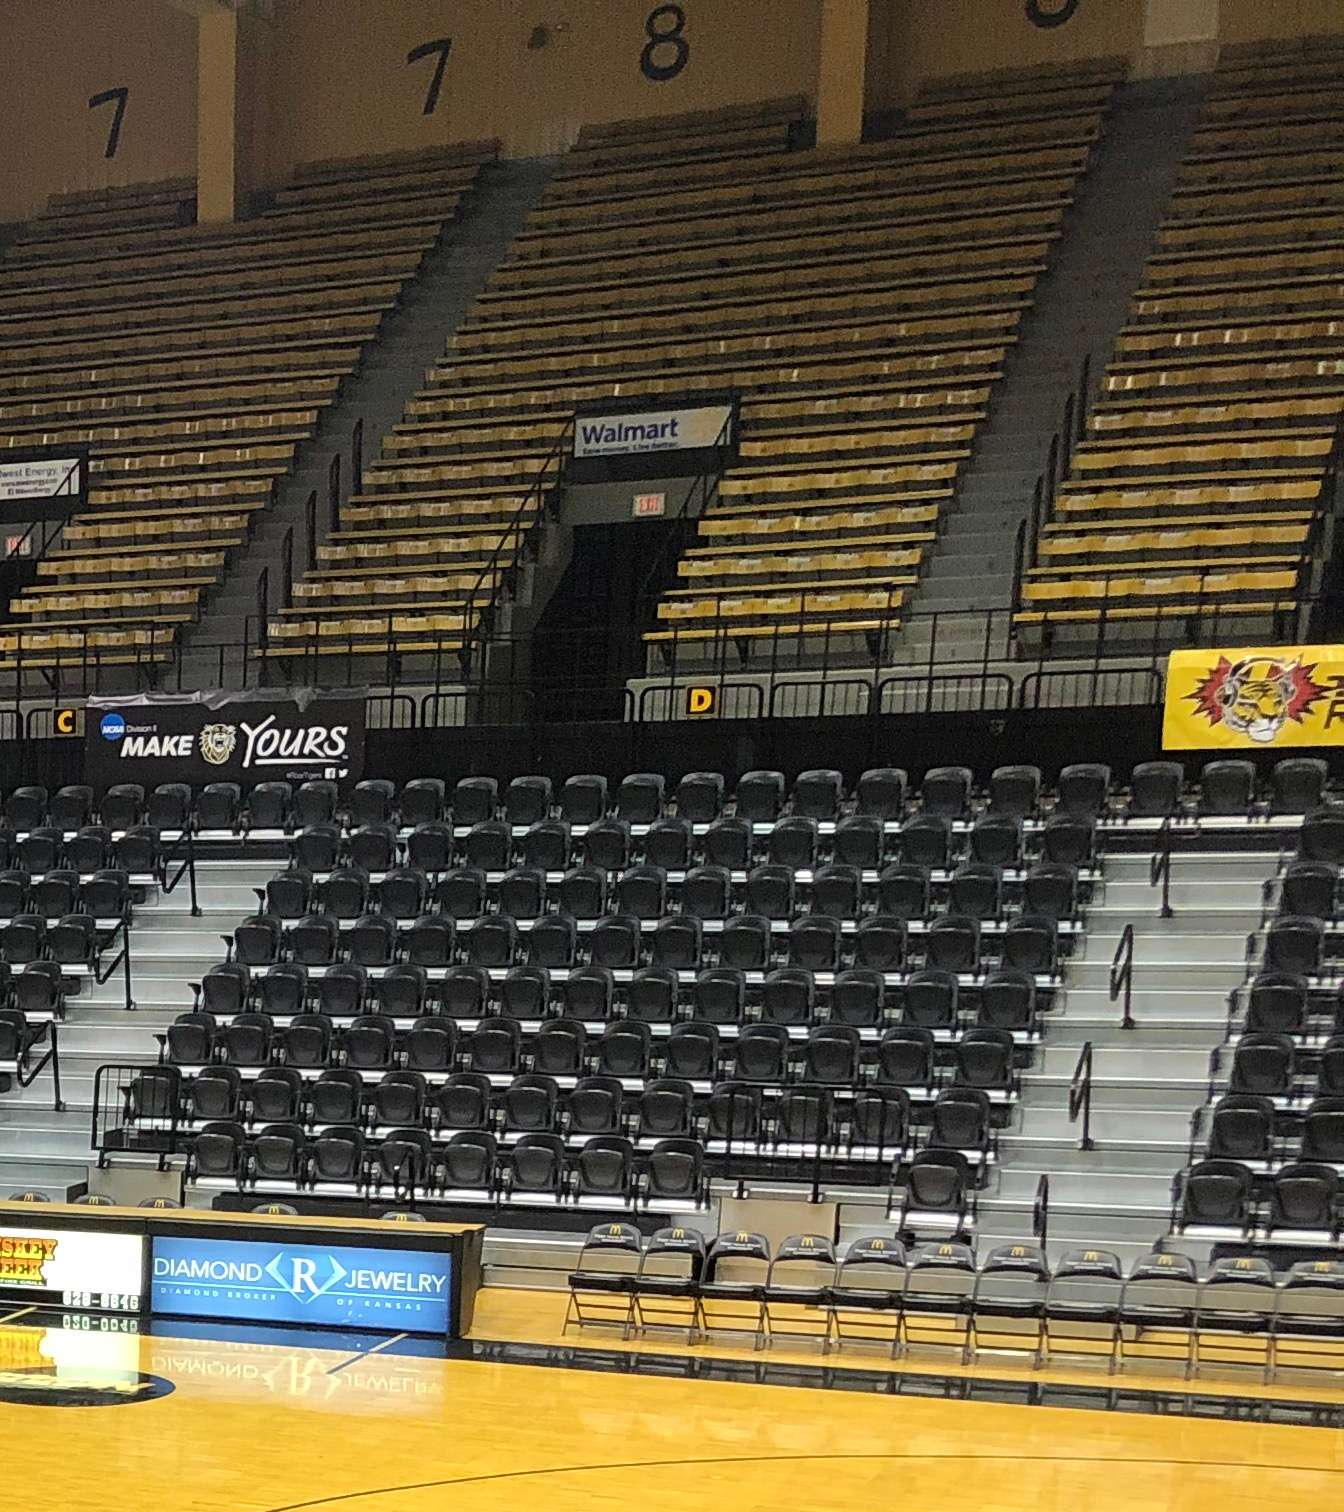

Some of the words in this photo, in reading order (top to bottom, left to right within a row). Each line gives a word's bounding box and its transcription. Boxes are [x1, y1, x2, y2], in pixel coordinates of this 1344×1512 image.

[640, 3, 690, 82] 8
[406, 38, 453, 116] 7
[88, 86, 130, 159] 7
[582, 418, 678, 444] Walmart
[692, 689, 710, 712] D
[57, 711, 73, 732] C
[120, 735, 194, 757] MAKE
[240, 715, 348, 768] YOURS
[154, 1258, 262, 1281] DIAMOND
[291, 1258, 320, 1295] R
[344, 1270, 446, 1293] JEWELRY
[161, 1287, 219, 1297] DIAMOND
[228, 1290, 277, 1300] BROKER
[364, 1300, 422, 1311] KANSAS
